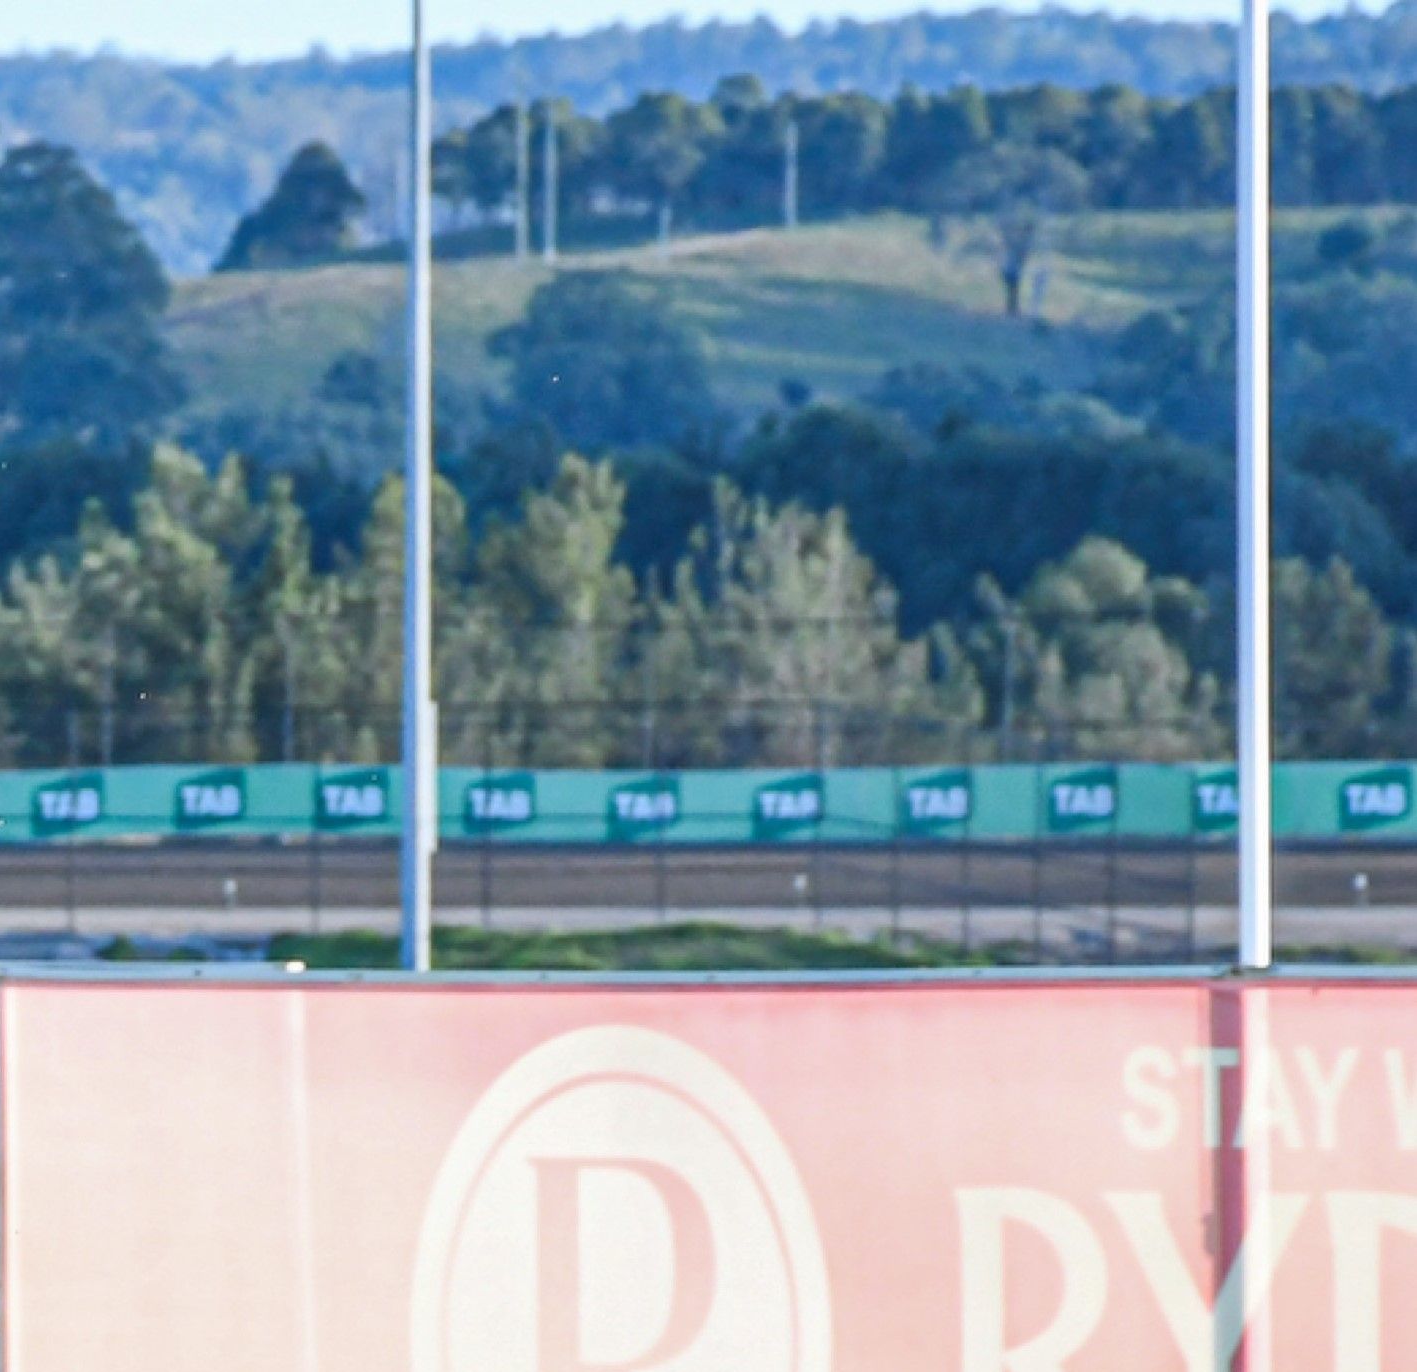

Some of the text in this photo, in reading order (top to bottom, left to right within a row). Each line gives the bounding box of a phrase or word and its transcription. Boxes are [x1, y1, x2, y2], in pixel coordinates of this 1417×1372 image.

[40, 790, 99, 819] TAB
[182, 786, 239, 815] TAB
[324, 786, 383, 816] TAB
[471, 788, 531, 819] TAB
[615, 793, 674, 819] TAB
[759, 789, 818, 818] TAB
[909, 787, 968, 817] TAB
[1054, 785, 1113, 815] TAB
[1198, 784, 1239, 815] TA
[1346, 783, 1405, 815] TAB
[1122, 1046, 1361, 1149] STAY
